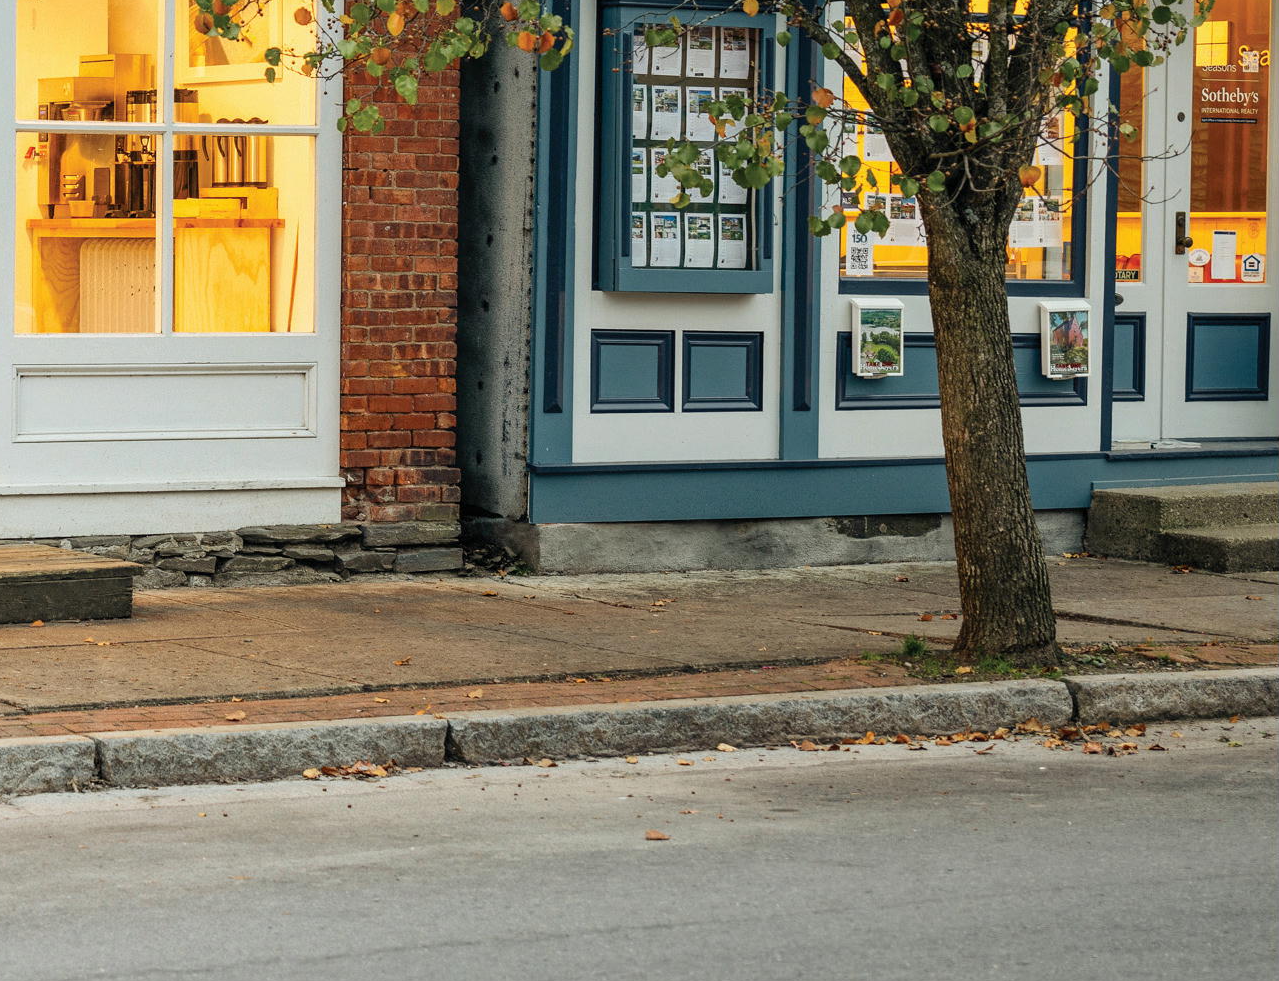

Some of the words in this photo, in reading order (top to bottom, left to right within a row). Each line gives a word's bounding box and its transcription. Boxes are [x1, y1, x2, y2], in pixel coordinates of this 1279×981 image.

[1201, 86, 1259, 107] Sotheby's
[851, 234, 868, 244] 150
[1115, 271, 1136, 279] OTARY
